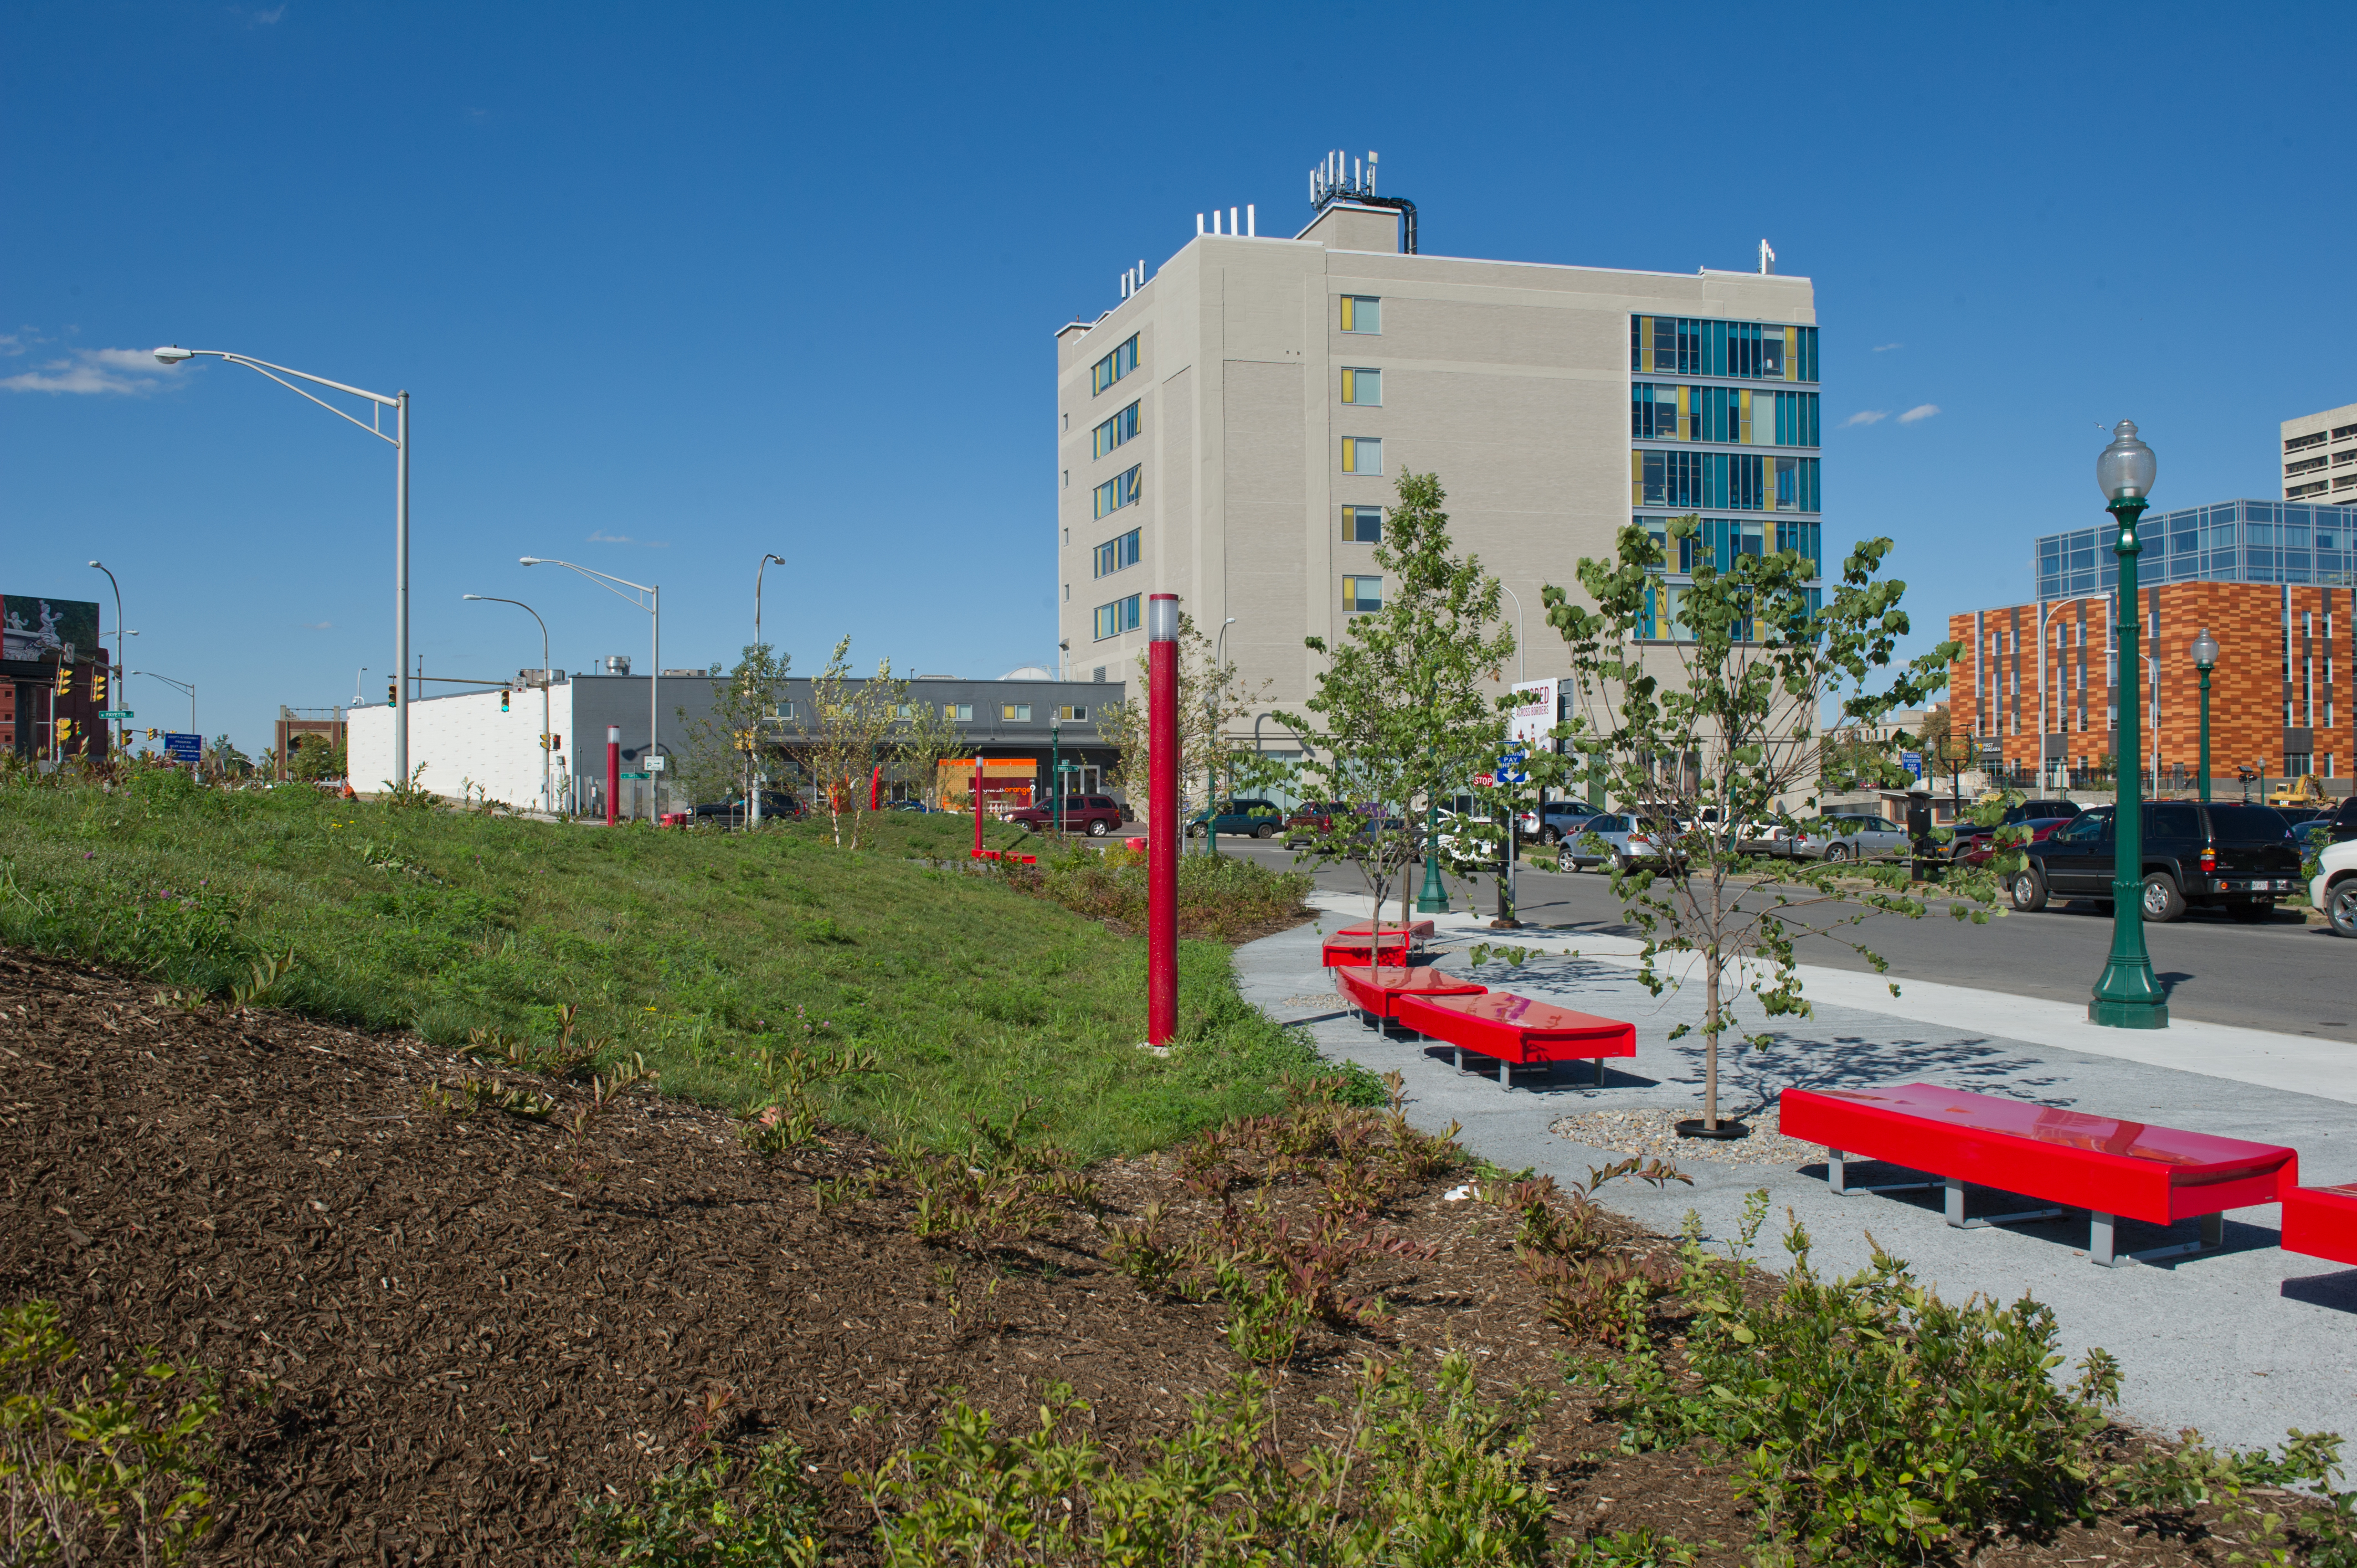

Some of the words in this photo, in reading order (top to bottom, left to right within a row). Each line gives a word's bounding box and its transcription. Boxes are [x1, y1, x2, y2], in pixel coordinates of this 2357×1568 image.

[1516, 707, 1530, 717] ACROSS
[1531, 705, 1549, 716] BORDERS
[1474, 777, 1493, 786] STOP
[1005, 784, 1036, 796] orange?
